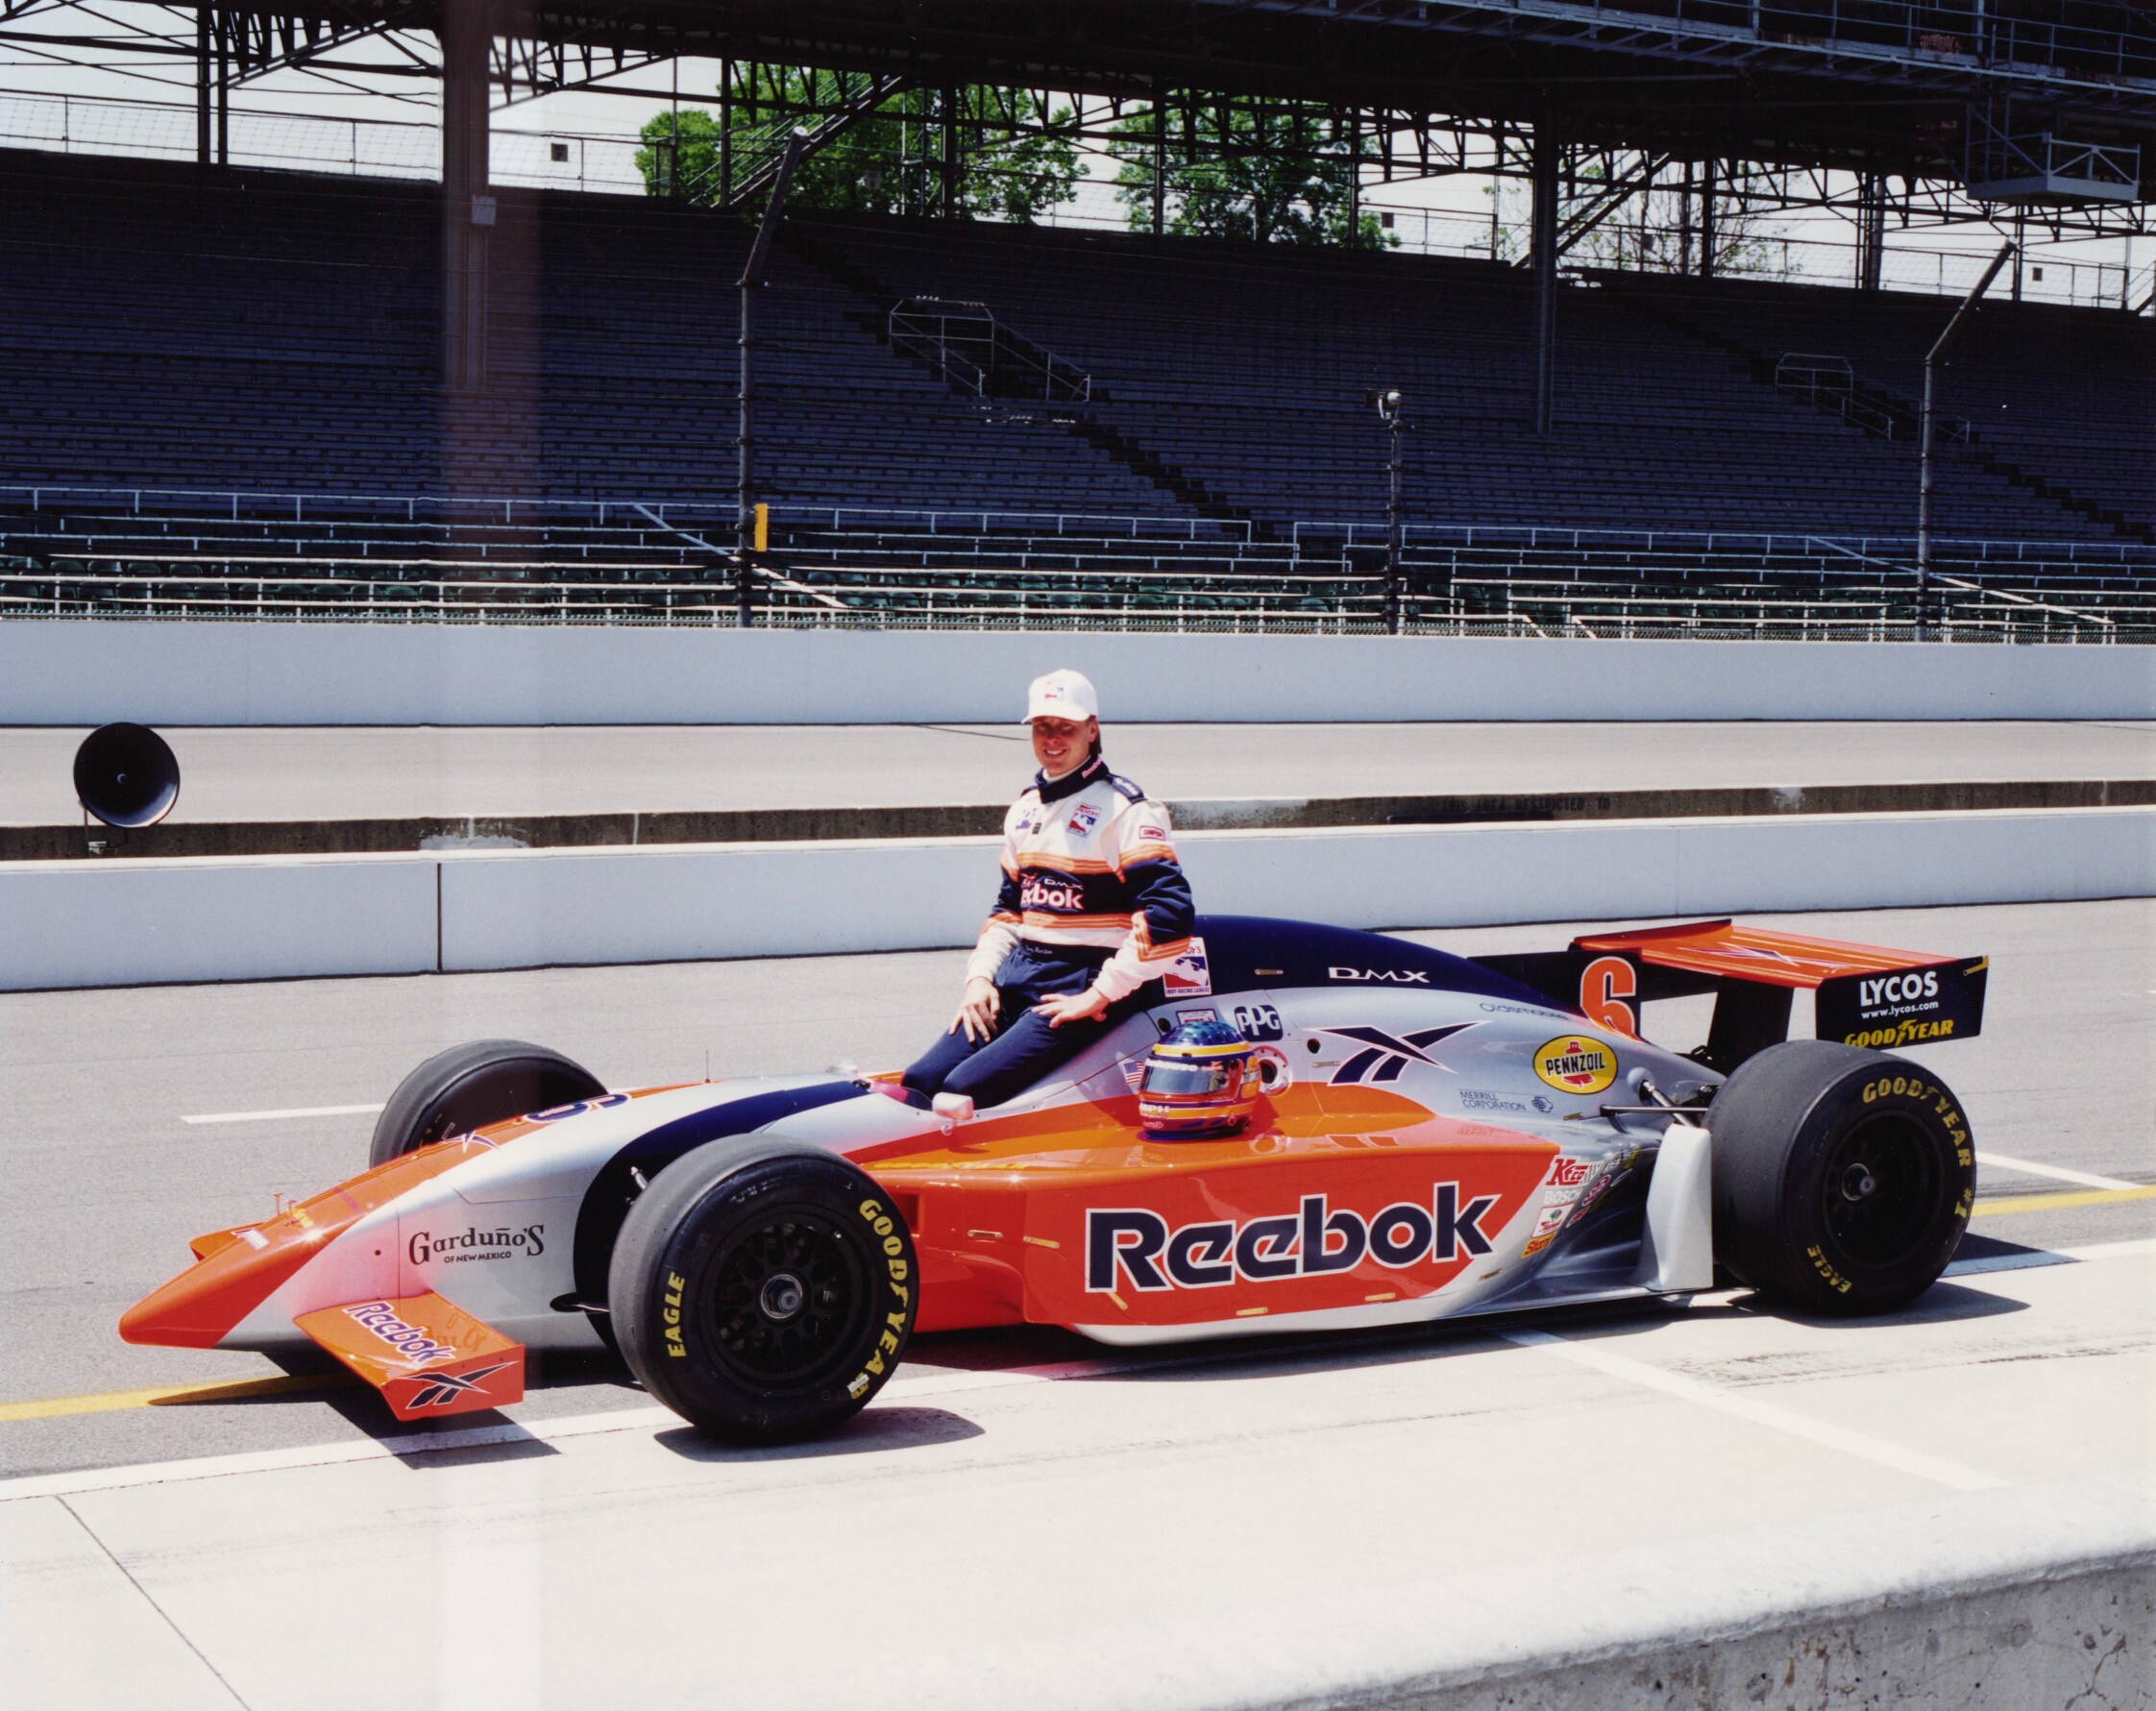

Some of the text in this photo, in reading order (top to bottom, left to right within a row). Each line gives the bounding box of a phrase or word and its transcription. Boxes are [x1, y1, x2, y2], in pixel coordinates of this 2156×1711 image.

[1475, 798, 1506, 811] AREA
[1515, 796, 1585, 811] RESTRICTED
[1043, 878, 1084, 891] DMX
[1328, 966, 1431, 984] DMX
[1859, 970, 1939, 1007] LYCOS
[1580, 956, 1637, 1044] 6
[1861, 1001, 1939, 1019] www.lycos.com
[1236, 1005, 1281, 1036] PPG
[1844, 1019, 1954, 1048] GOODYEAR
[1545, 1051, 1606, 1076] PENNZOIL
[1459, 1091, 1499, 1101] MERRILL
[1462, 1099, 1527, 1111] CORPORATION
[1862, 1077, 1972, 1167] GOODYEAR
[1543, 1188, 1583, 1205] BOSCH
[1085, 1180, 1503, 1292] Reebok
[456, 1254, 478, 1262] NEW
[478, 1251, 512, 1260] MEXICO
[1807, 1244, 1852, 1294] EAGLE
[663, 1271, 686, 1357] EAGLE
[342, 1301, 457, 1365] Reebok
